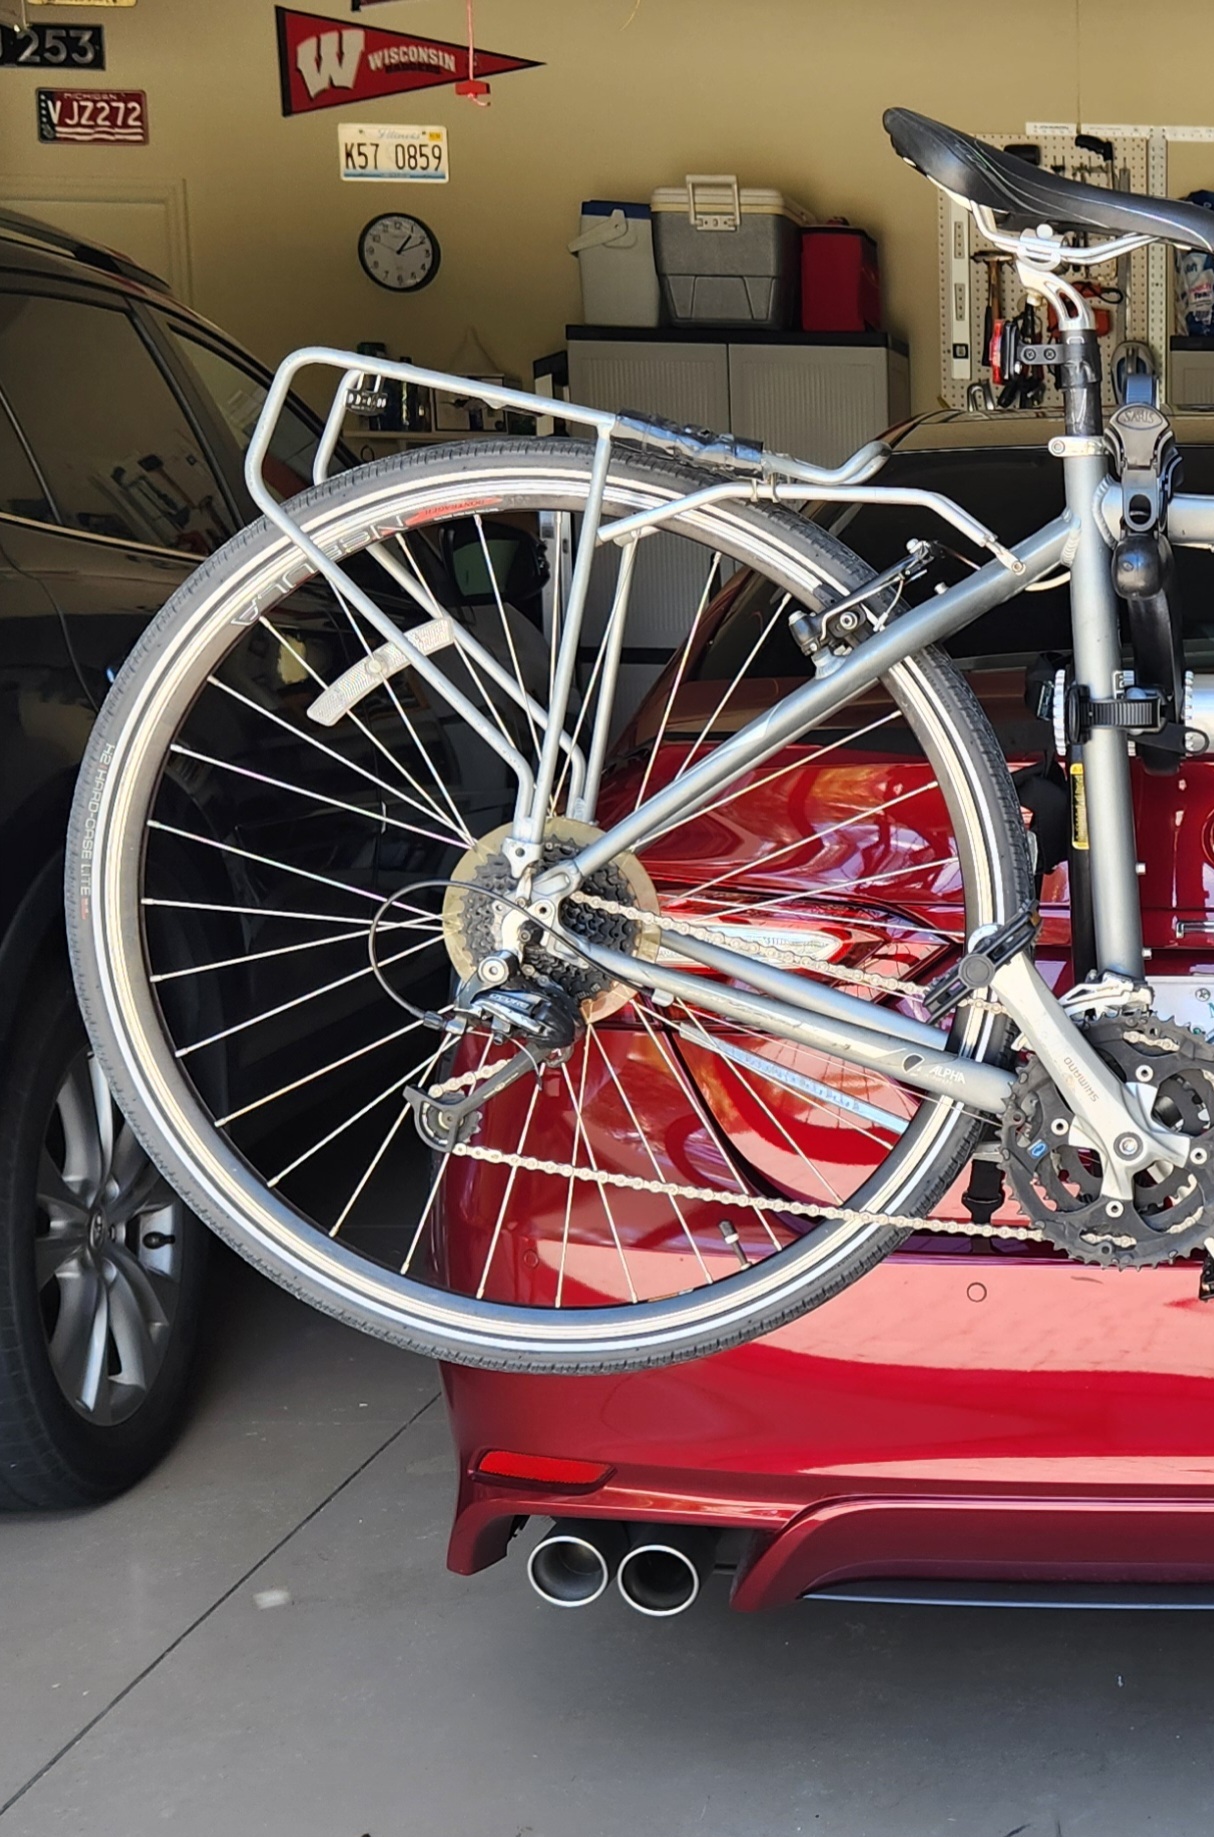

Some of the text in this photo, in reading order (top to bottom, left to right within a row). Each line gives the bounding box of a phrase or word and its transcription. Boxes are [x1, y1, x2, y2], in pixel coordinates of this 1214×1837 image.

[367, 45, 457, 73] WISCONSIN
[47, 100, 142, 125] VJZ272
[344, 142, 443, 172] K57 0859
[929, 1064, 967, 1085] ALPHA
